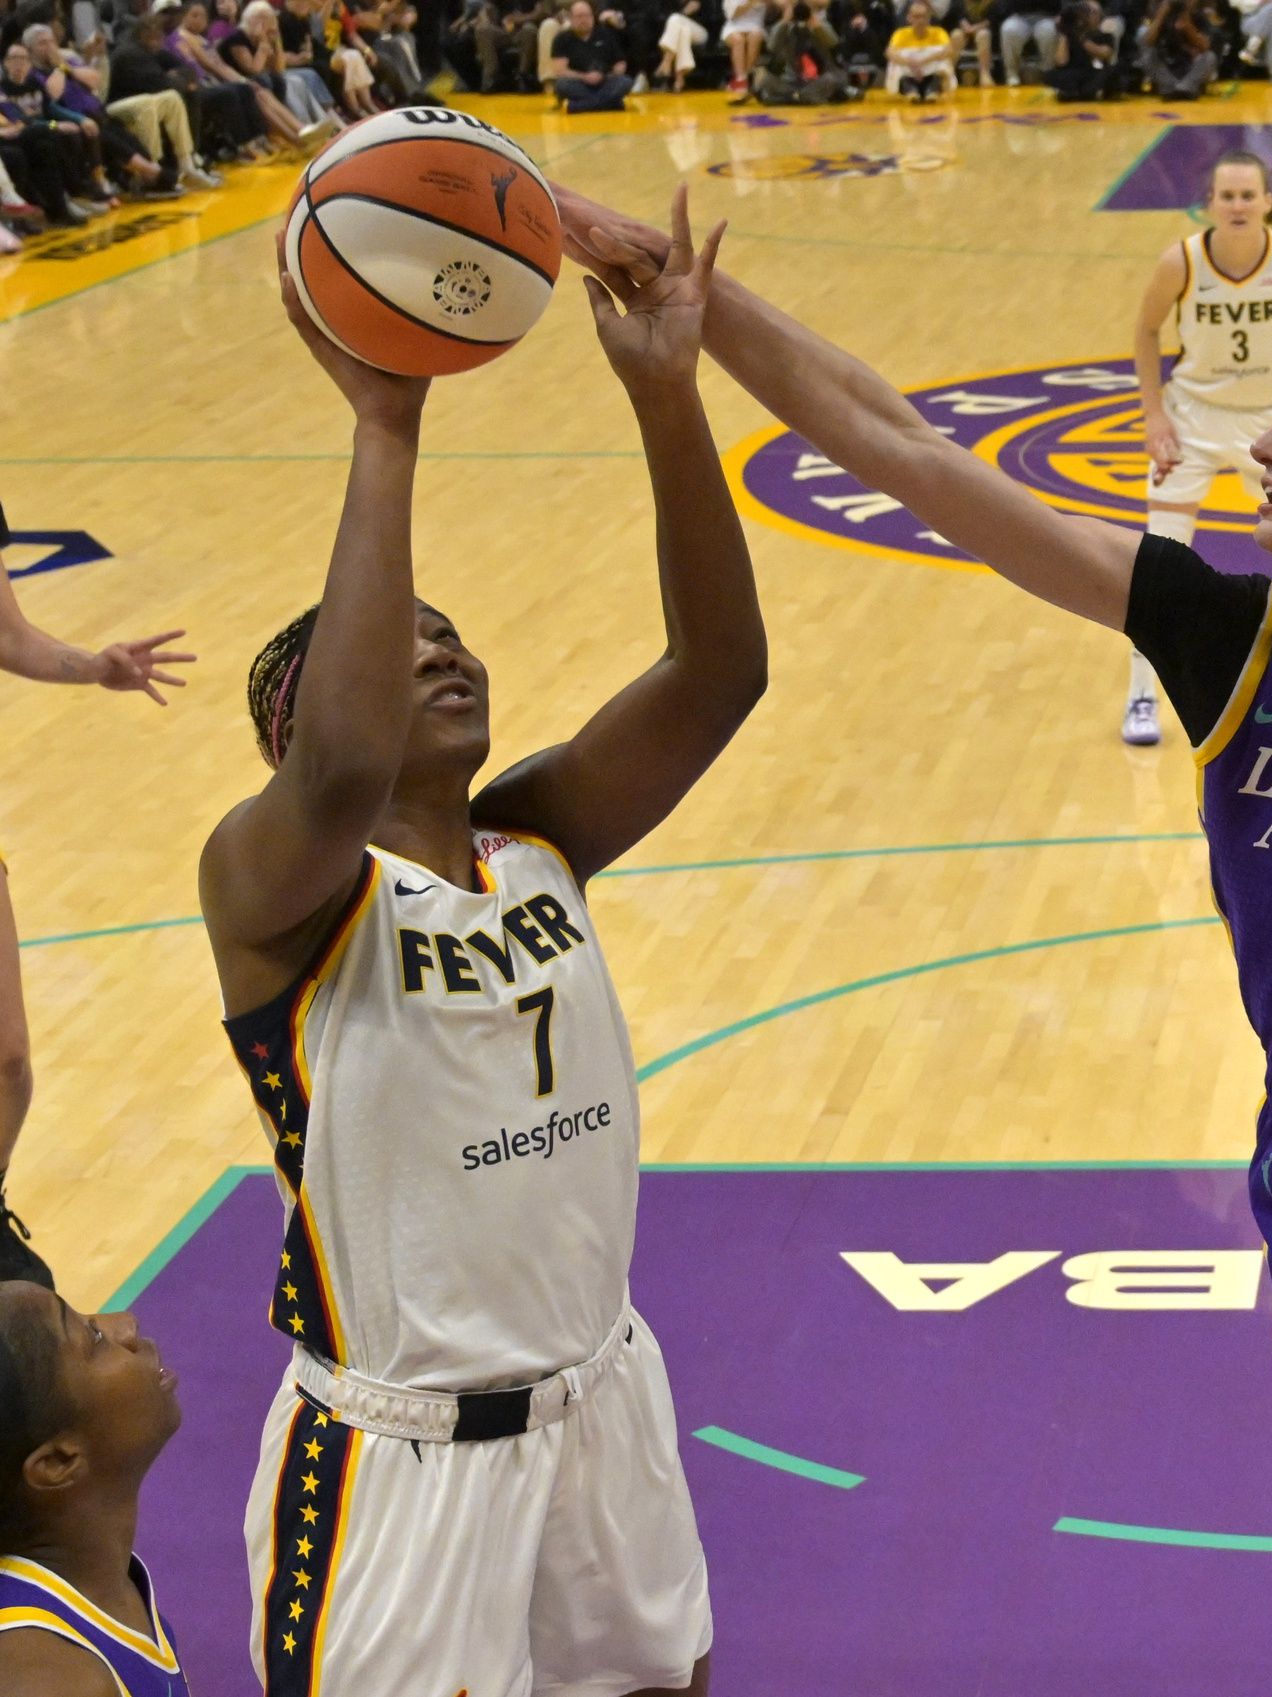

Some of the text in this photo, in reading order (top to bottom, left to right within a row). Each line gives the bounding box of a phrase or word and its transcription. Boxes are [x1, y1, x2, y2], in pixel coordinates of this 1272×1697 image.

[1231, 330, 1249, 363] 3
[396, 893, 586, 995] FEVER
[515, 984, 556, 1100] 7
[462, 1102, 611, 1171] salesforce
